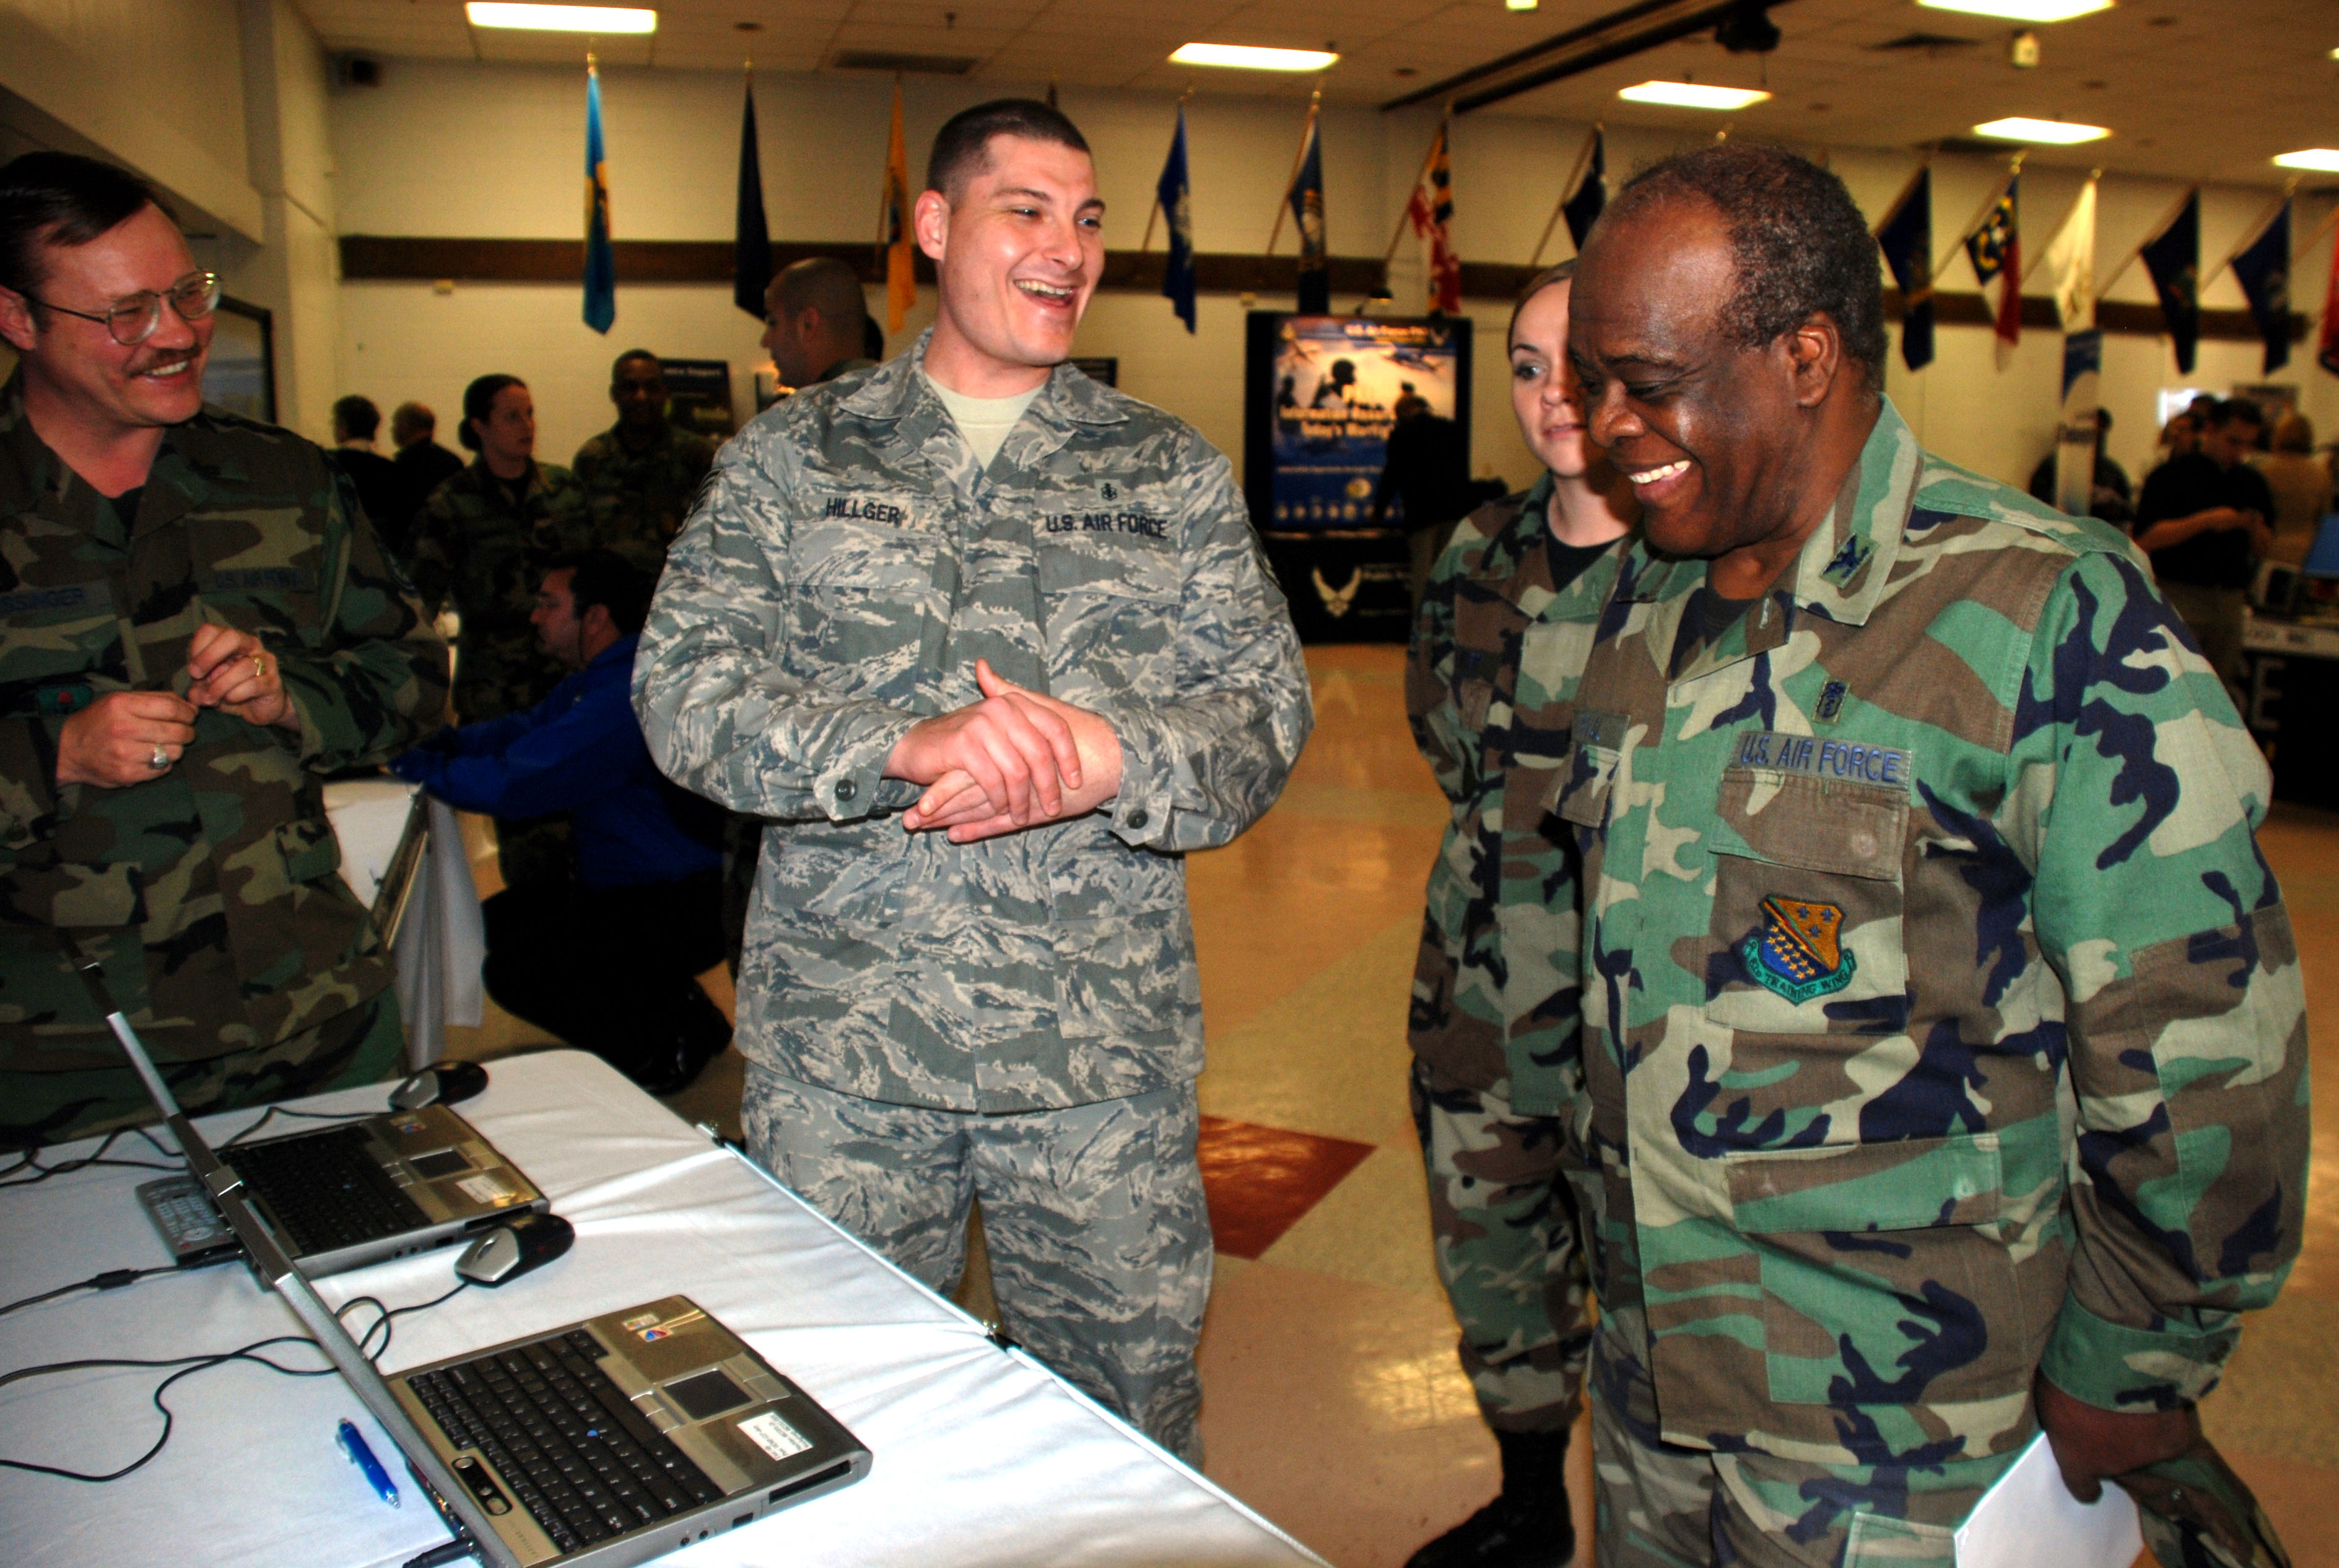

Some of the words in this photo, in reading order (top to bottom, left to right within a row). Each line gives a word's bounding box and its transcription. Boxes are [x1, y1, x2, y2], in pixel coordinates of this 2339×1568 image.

[826, 497, 900, 526] HILLGER
[1046, 514, 1078, 533] U.S.
[1082, 513, 1113, 531] AIR
[1117, 512, 1167, 539] FORCE
[1740, 734, 1771, 765] U.S.
[1777, 738, 1814, 770] AIR
[1818, 741, 1901, 783] FORCE
[1765, 974, 1817, 999] TRAINING
[1821, 969, 1848, 990] WING
